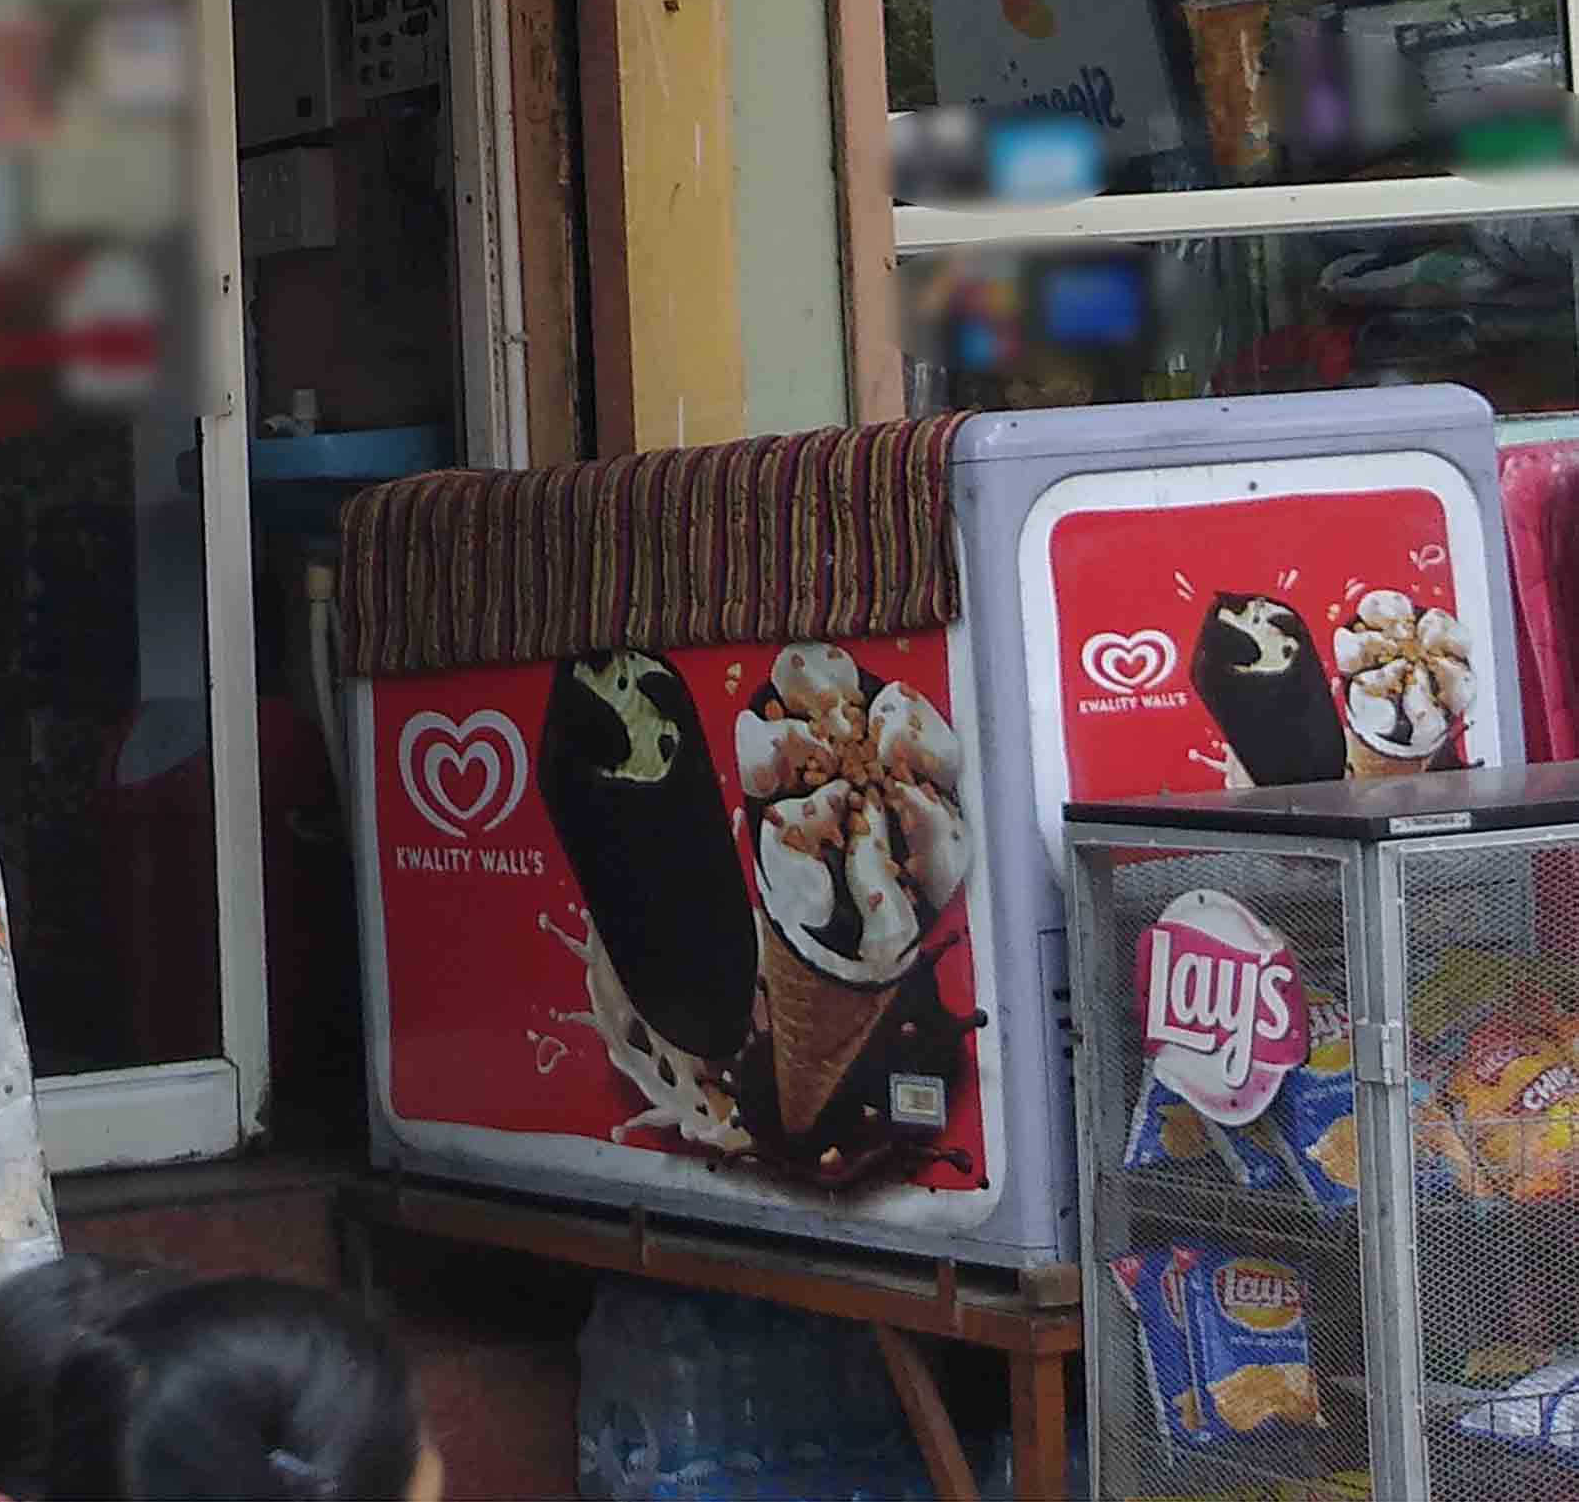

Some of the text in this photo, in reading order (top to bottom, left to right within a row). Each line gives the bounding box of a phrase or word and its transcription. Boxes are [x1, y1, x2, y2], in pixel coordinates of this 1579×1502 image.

[1079, 695, 1136, 714] KWALITY
[396, 846, 545, 875] KWALITY WALL'S
[1147, 928, 1293, 1089] Lay's
